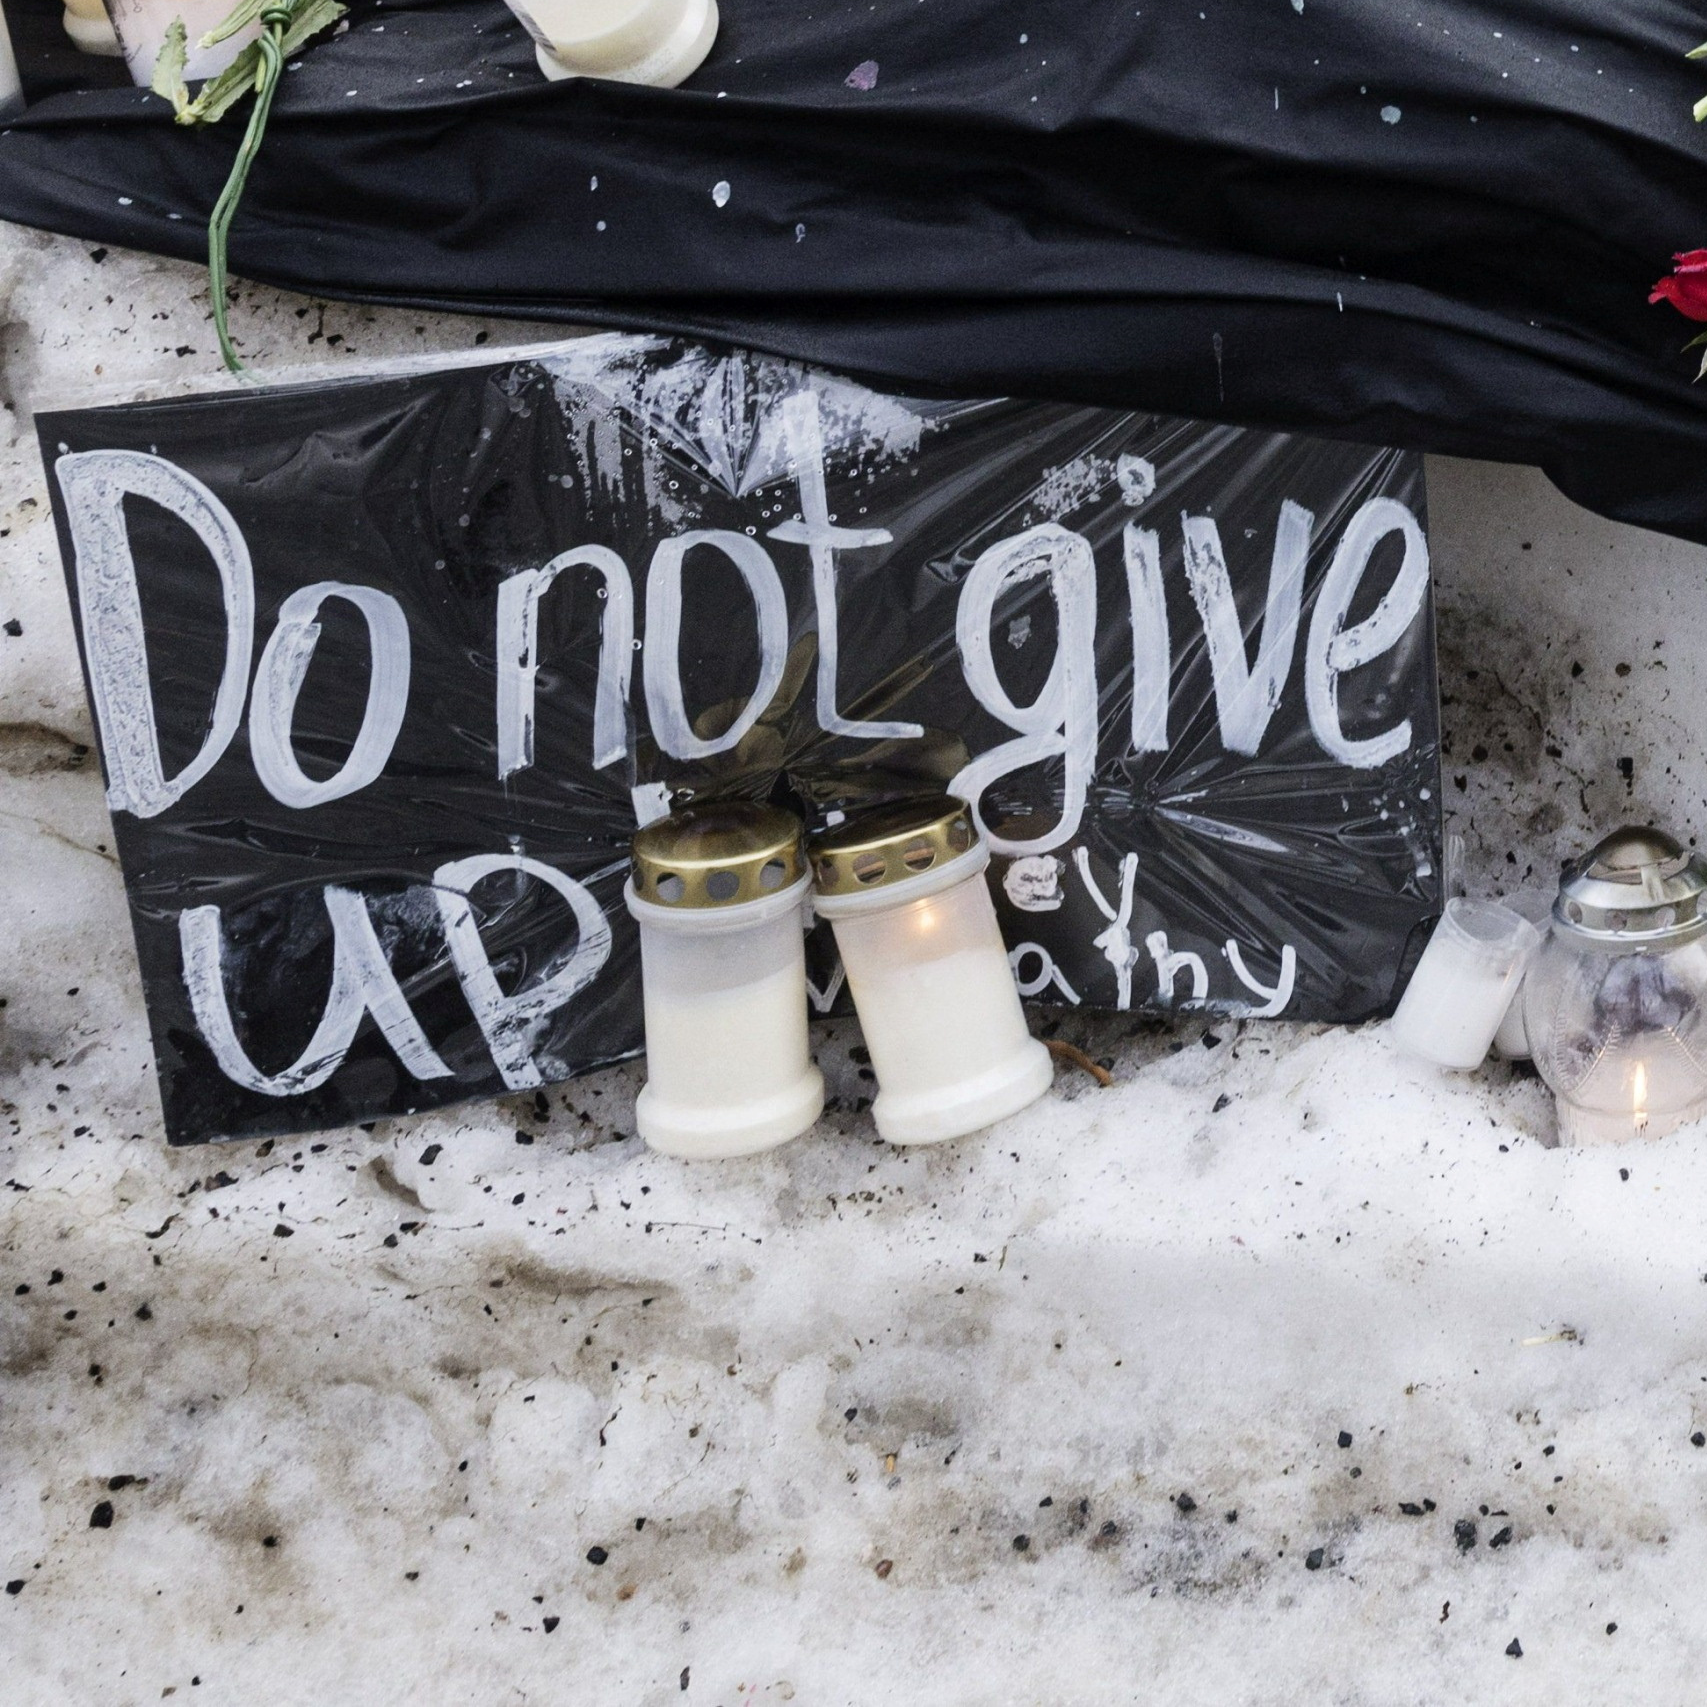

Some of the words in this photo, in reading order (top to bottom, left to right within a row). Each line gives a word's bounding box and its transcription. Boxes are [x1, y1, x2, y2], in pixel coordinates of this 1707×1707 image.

[54, 448, 412, 819] Do
[496, 389, 925, 781] not
[946, 453, 1433, 855] give
